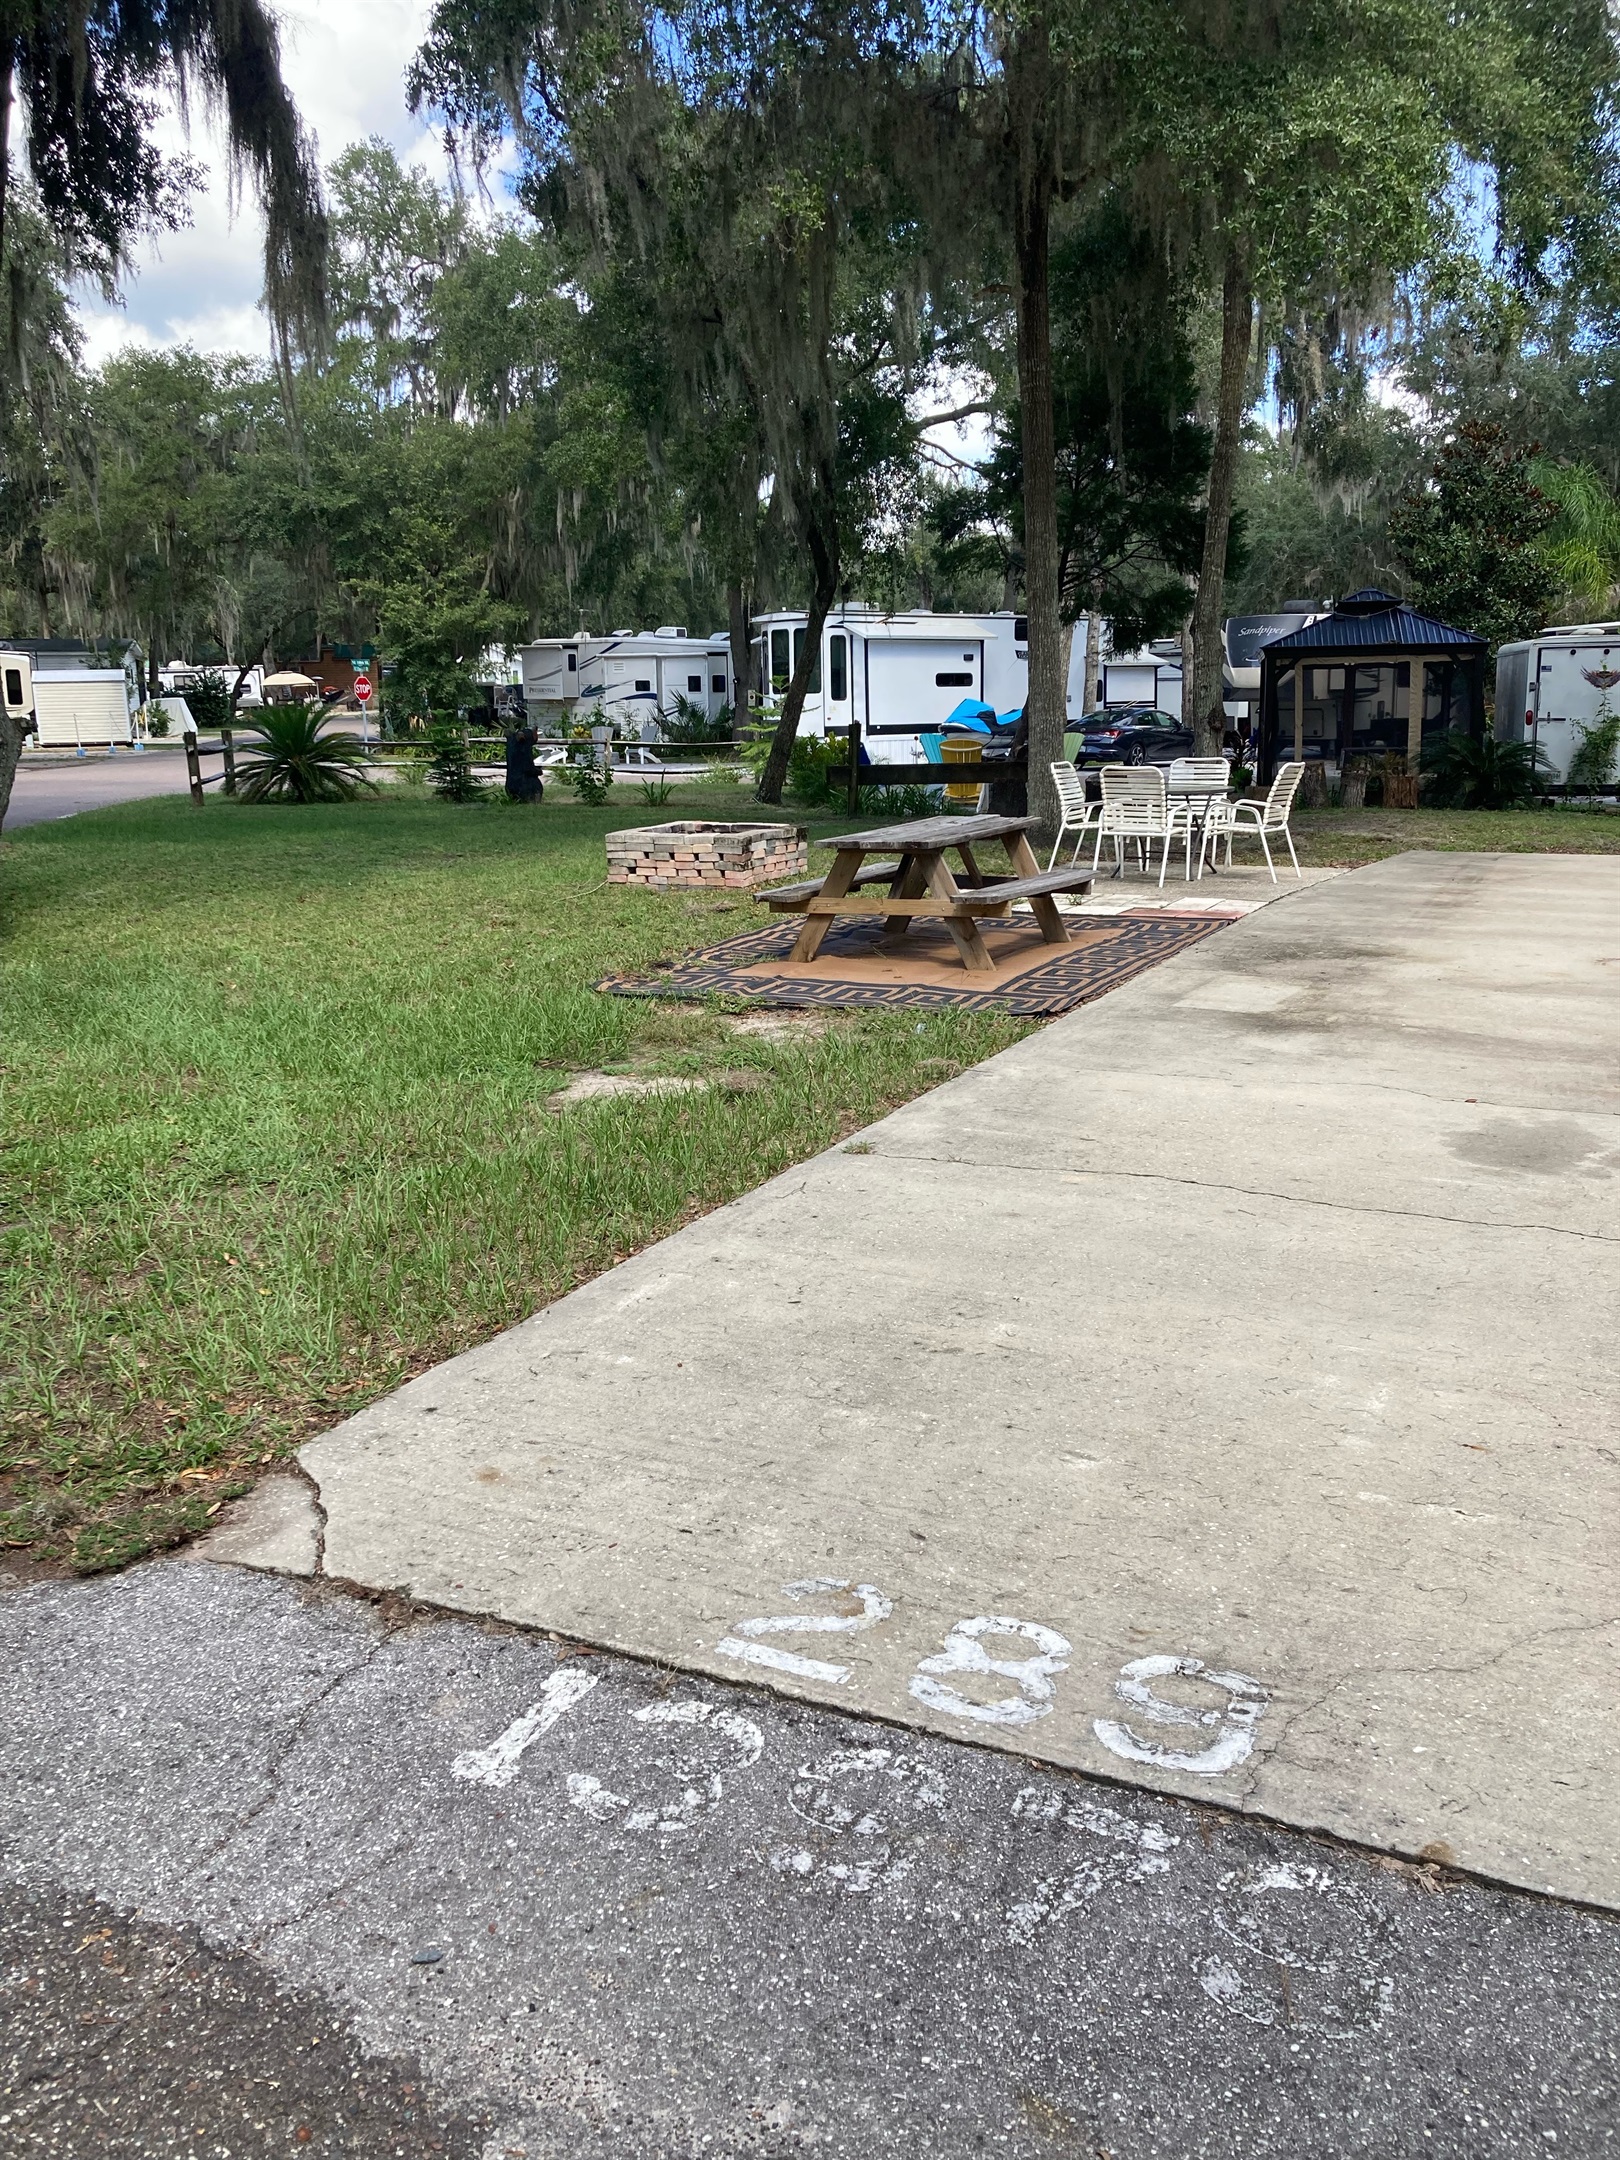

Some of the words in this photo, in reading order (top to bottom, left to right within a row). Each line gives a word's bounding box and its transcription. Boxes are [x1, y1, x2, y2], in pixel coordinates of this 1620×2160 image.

[1238, 625, 1286, 637] Sandpiper
[355, 684, 370, 694] STOP
[714, 1577, 1272, 1774] 289
